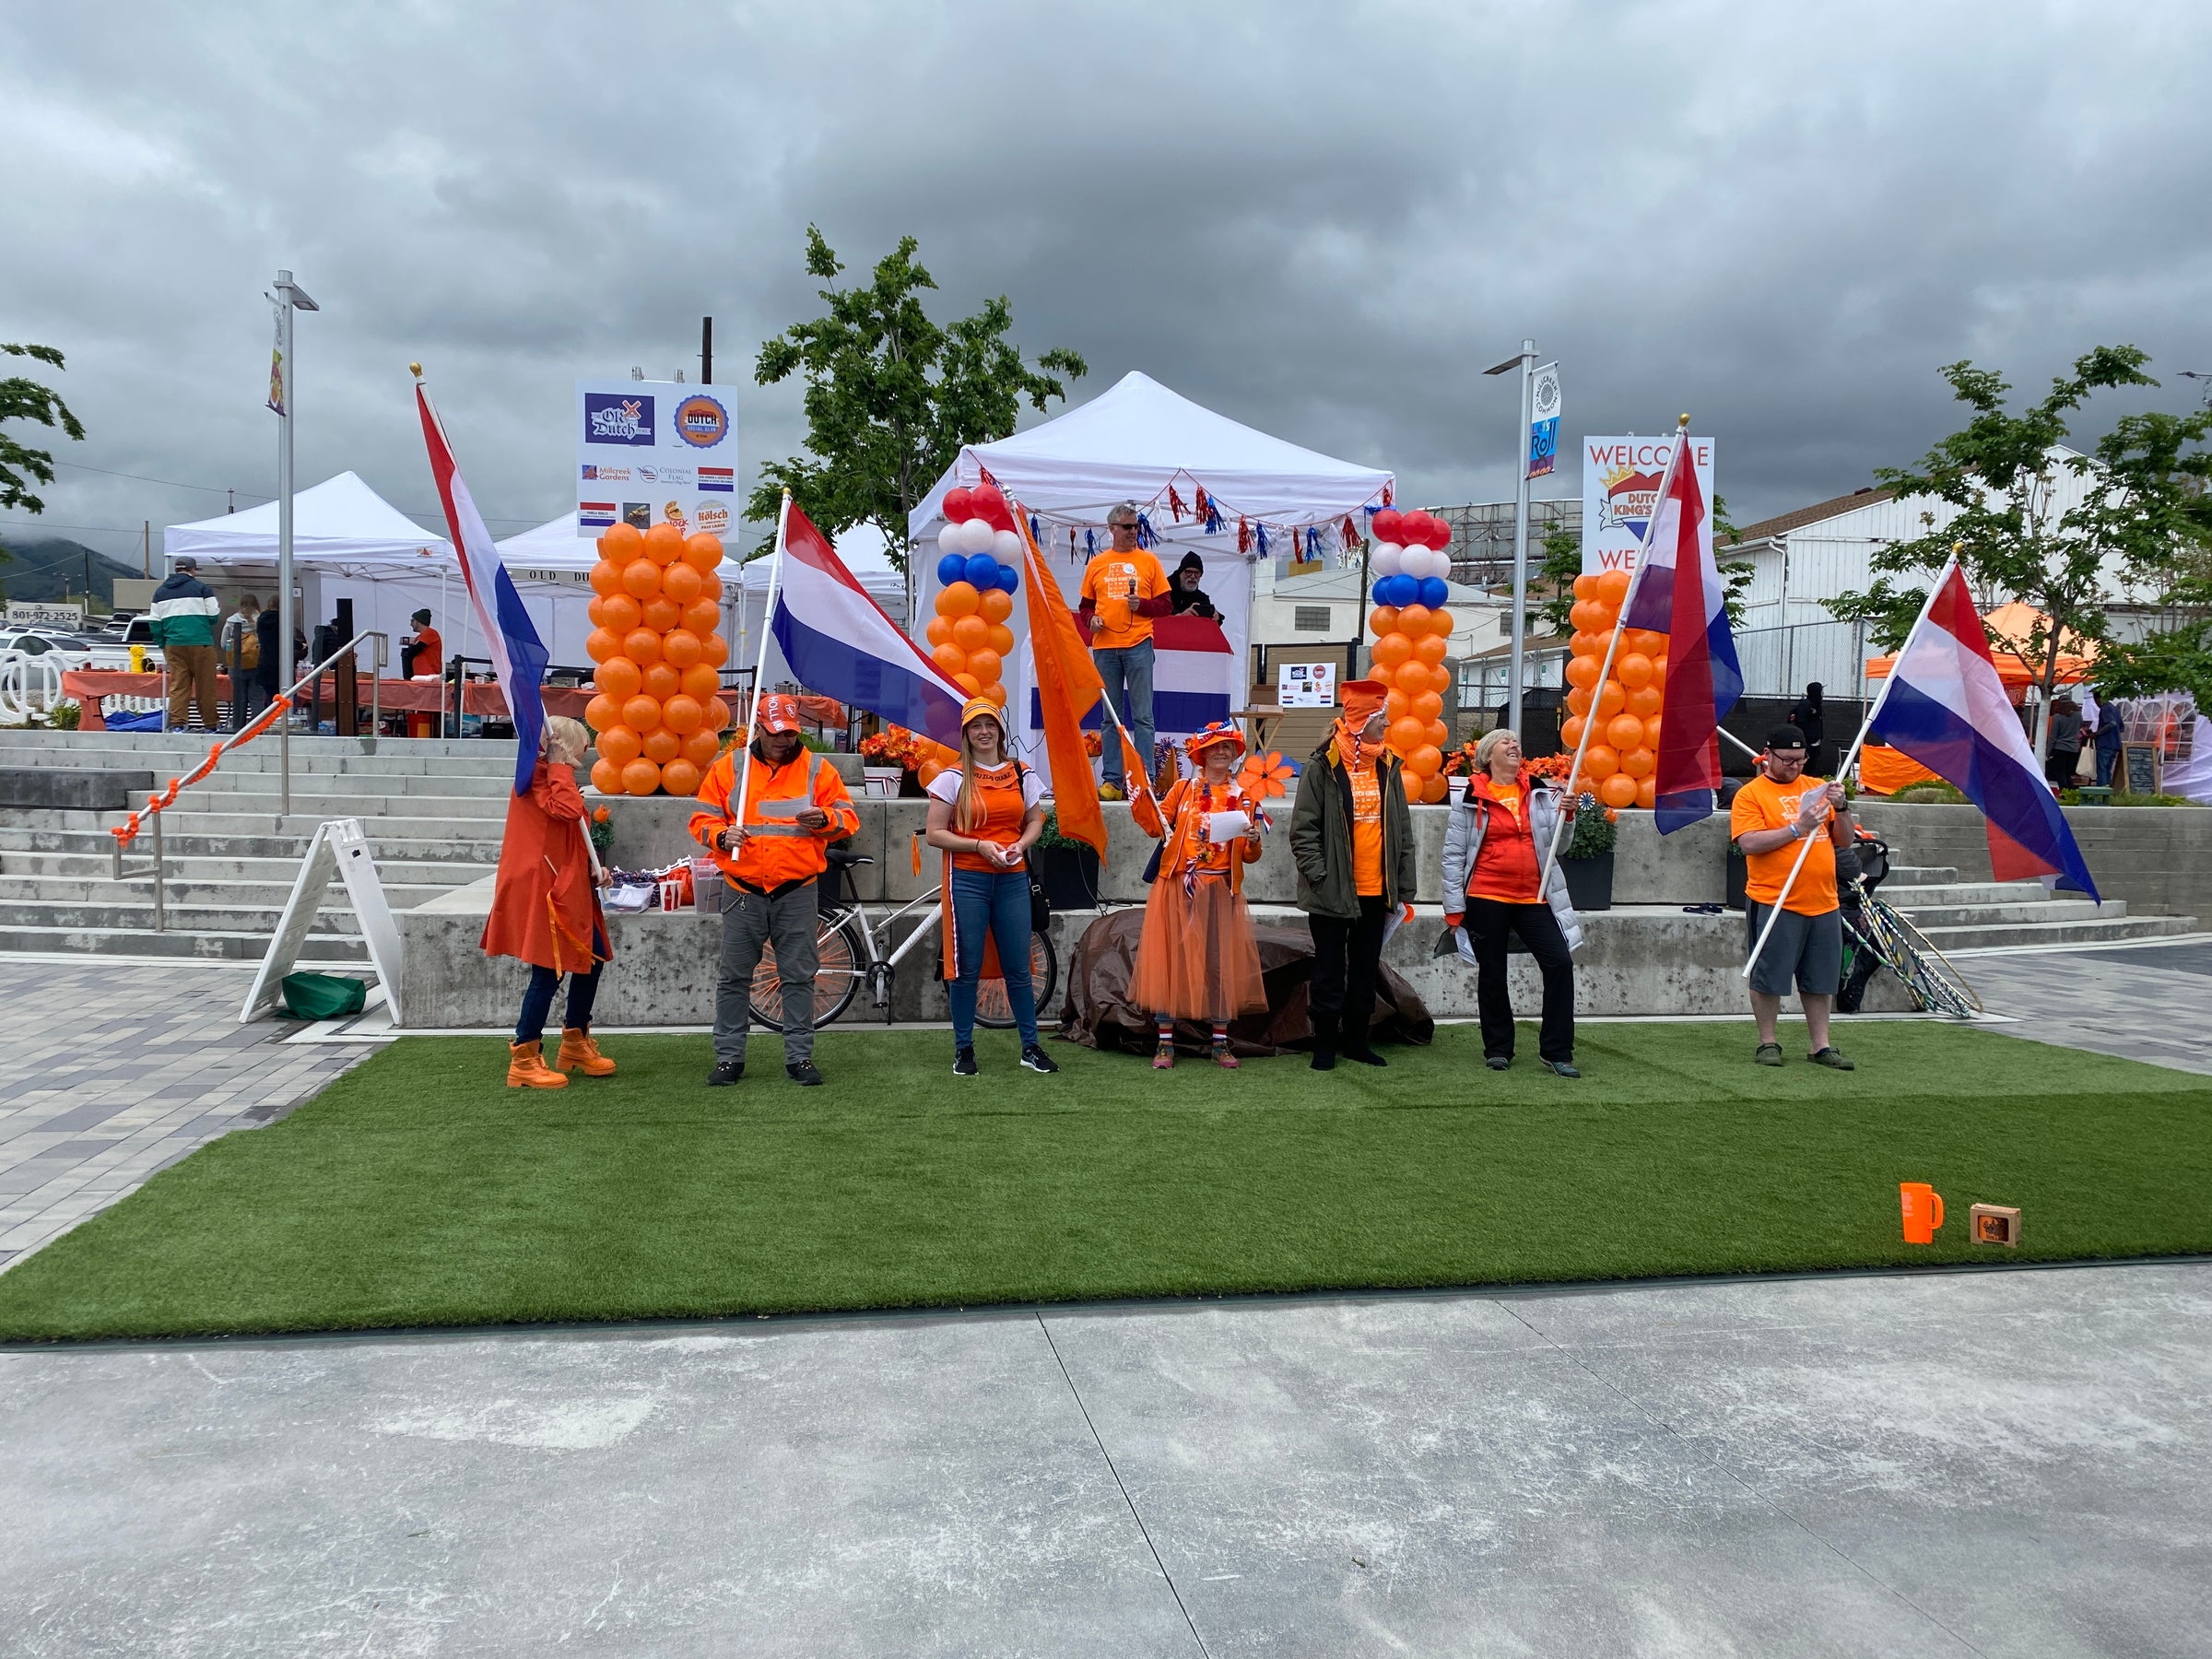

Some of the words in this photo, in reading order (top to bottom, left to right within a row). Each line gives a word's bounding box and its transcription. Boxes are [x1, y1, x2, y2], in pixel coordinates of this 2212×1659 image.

[1535, 396, 1558, 414] COMMON
[603, 410, 626, 423] Old
[688, 413, 717, 425] DUTCH
[594, 421, 636, 435] Dutch
[1532, 419, 1550, 435] Let's
[1531, 420, 1557, 457] Roll
[1589, 445, 1709, 466] WELCOE
[599, 466, 631, 476] Millcreek
[659, 466, 691, 475] COLONIAL
[599, 473, 630, 481] Gardens
[1628, 493, 1657, 504] DUTC
[698, 508, 728, 522] Hölsch
[1614, 505, 1652, 515] KING'S
[1598, 549, 1635, 570] WE
[529, 571, 557, 581] OLD
[574, 572, 590, 582] DU
[12, 610, 77, 621] 801-972-2525
